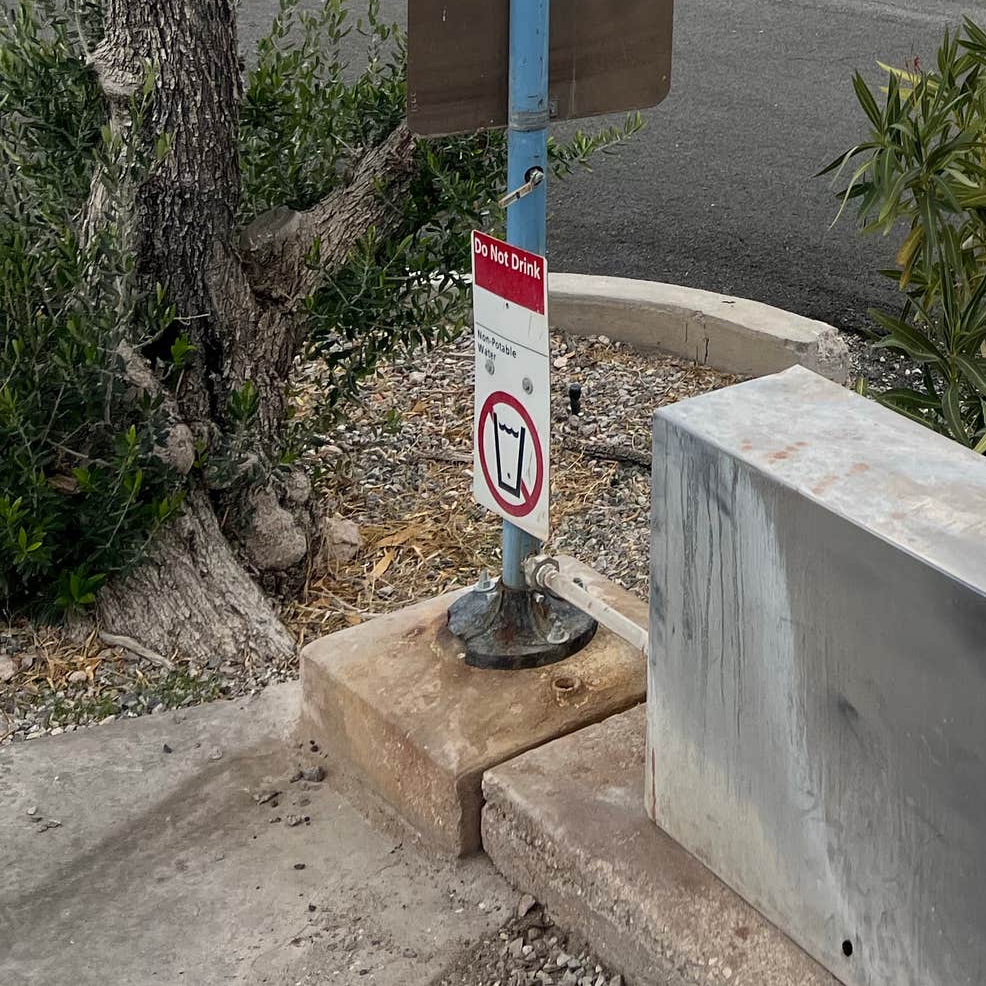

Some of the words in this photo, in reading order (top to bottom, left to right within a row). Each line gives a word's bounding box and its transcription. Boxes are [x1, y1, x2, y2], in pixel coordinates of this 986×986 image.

[474, 237, 488, 258] Do
[490, 244, 509, 268] Not
[511, 253, 541, 280] Drink
[477, 329, 517, 359] Non-Potable
[477, 343, 497, 361] Water
